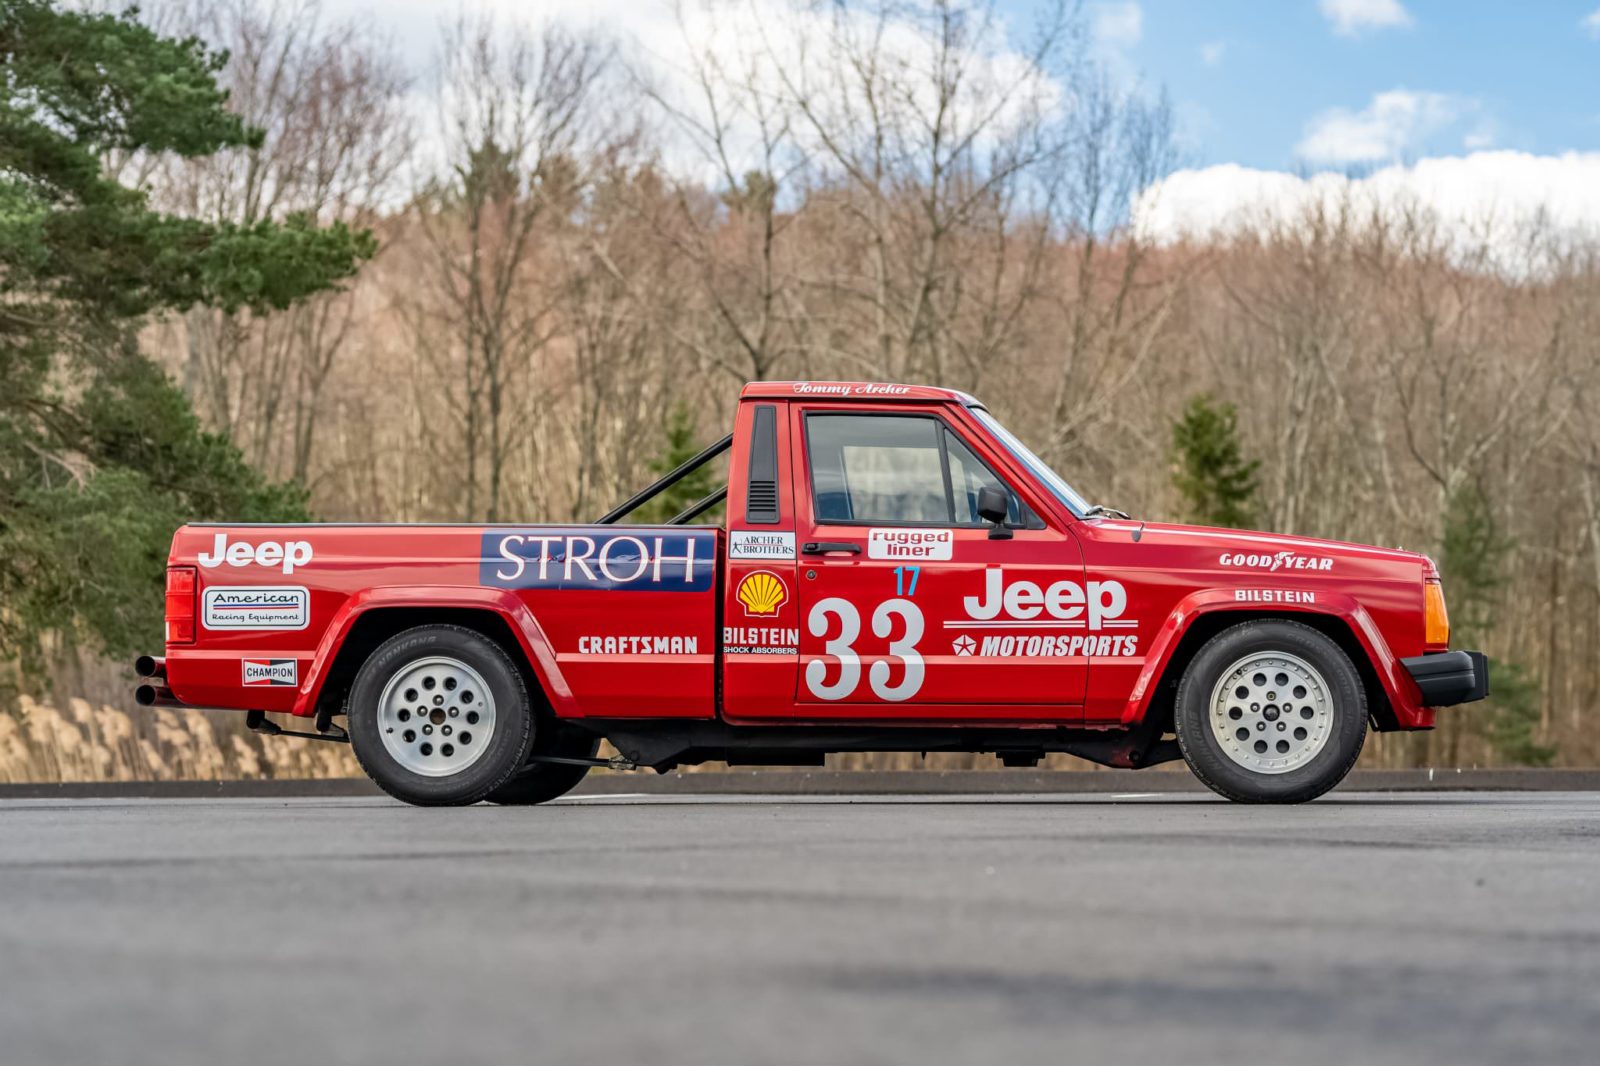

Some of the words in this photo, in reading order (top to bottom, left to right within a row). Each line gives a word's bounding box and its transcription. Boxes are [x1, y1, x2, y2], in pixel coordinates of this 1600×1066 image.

[793, 383, 851, 396] Tommy
[855, 383, 910, 394] Archer
[743, 536, 783, 544] ARCHER
[873, 532, 949, 544] rugged
[198, 533, 313, 575] Jeep
[743, 545, 794, 554] BROTHERS
[887, 544, 935, 556] liner
[496, 534, 696, 583] STROH
[1219, 551, 1334, 571] GOODYEAR
[893, 566, 921, 596] 17
[213, 593, 299, 603] American
[963, 568, 1127, 630] Jeep
[1235, 589, 1315, 603] BILSTEIN
[212, 613, 245, 623] Racing
[249, 613, 299, 623] Equipment
[723, 627, 799, 645] BILSTEIN
[578, 636, 698, 654] CRAFTSMAN
[751, 647, 797, 655] ABSORBERS
[806, 597, 925, 701] 33
[980, 635, 1139, 656] MOTORSPORTS
[246, 667, 293, 678] CHAMPION
